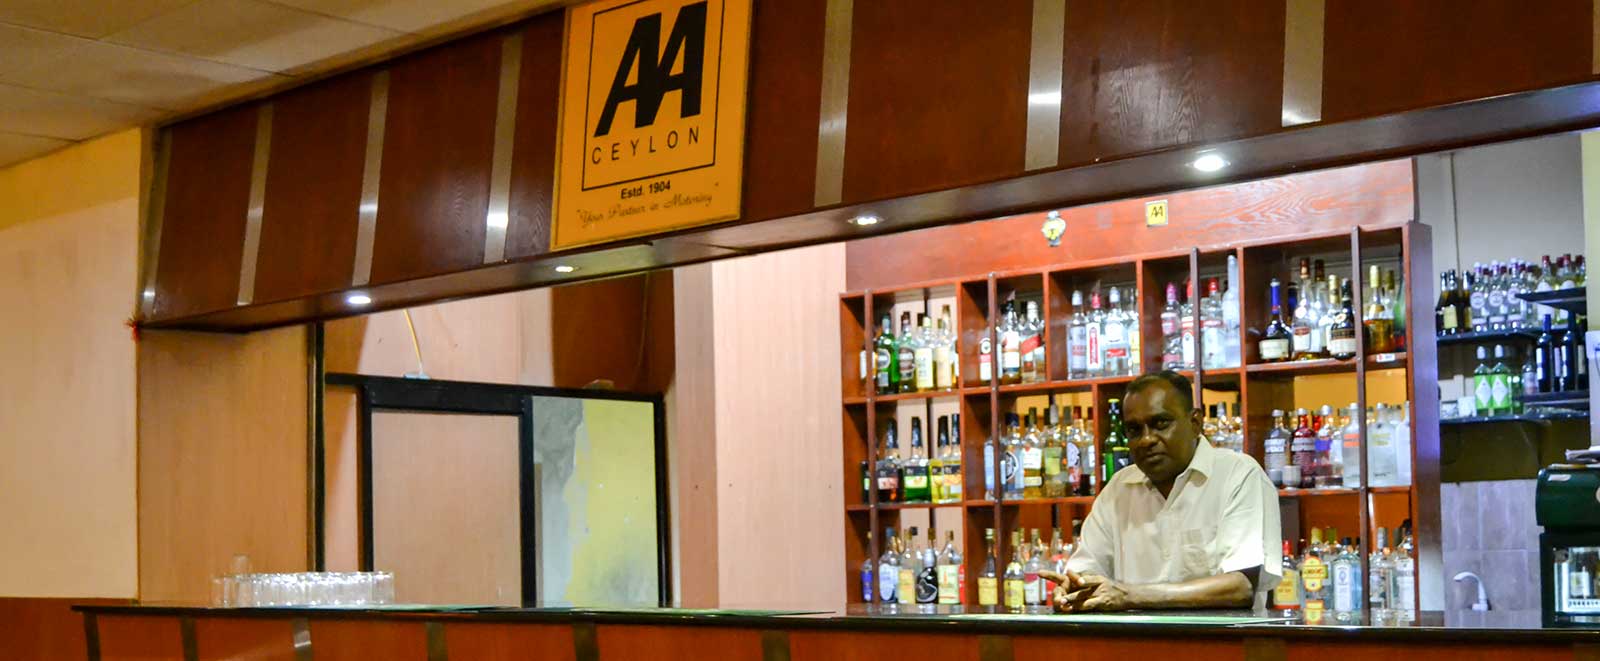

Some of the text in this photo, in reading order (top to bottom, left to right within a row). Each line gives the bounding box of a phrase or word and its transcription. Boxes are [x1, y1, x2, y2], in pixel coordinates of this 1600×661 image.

[593, 0, 708, 138] AA
[591, 126, 700, 164] CEYLON
[648, 180, 671, 194] 1904
